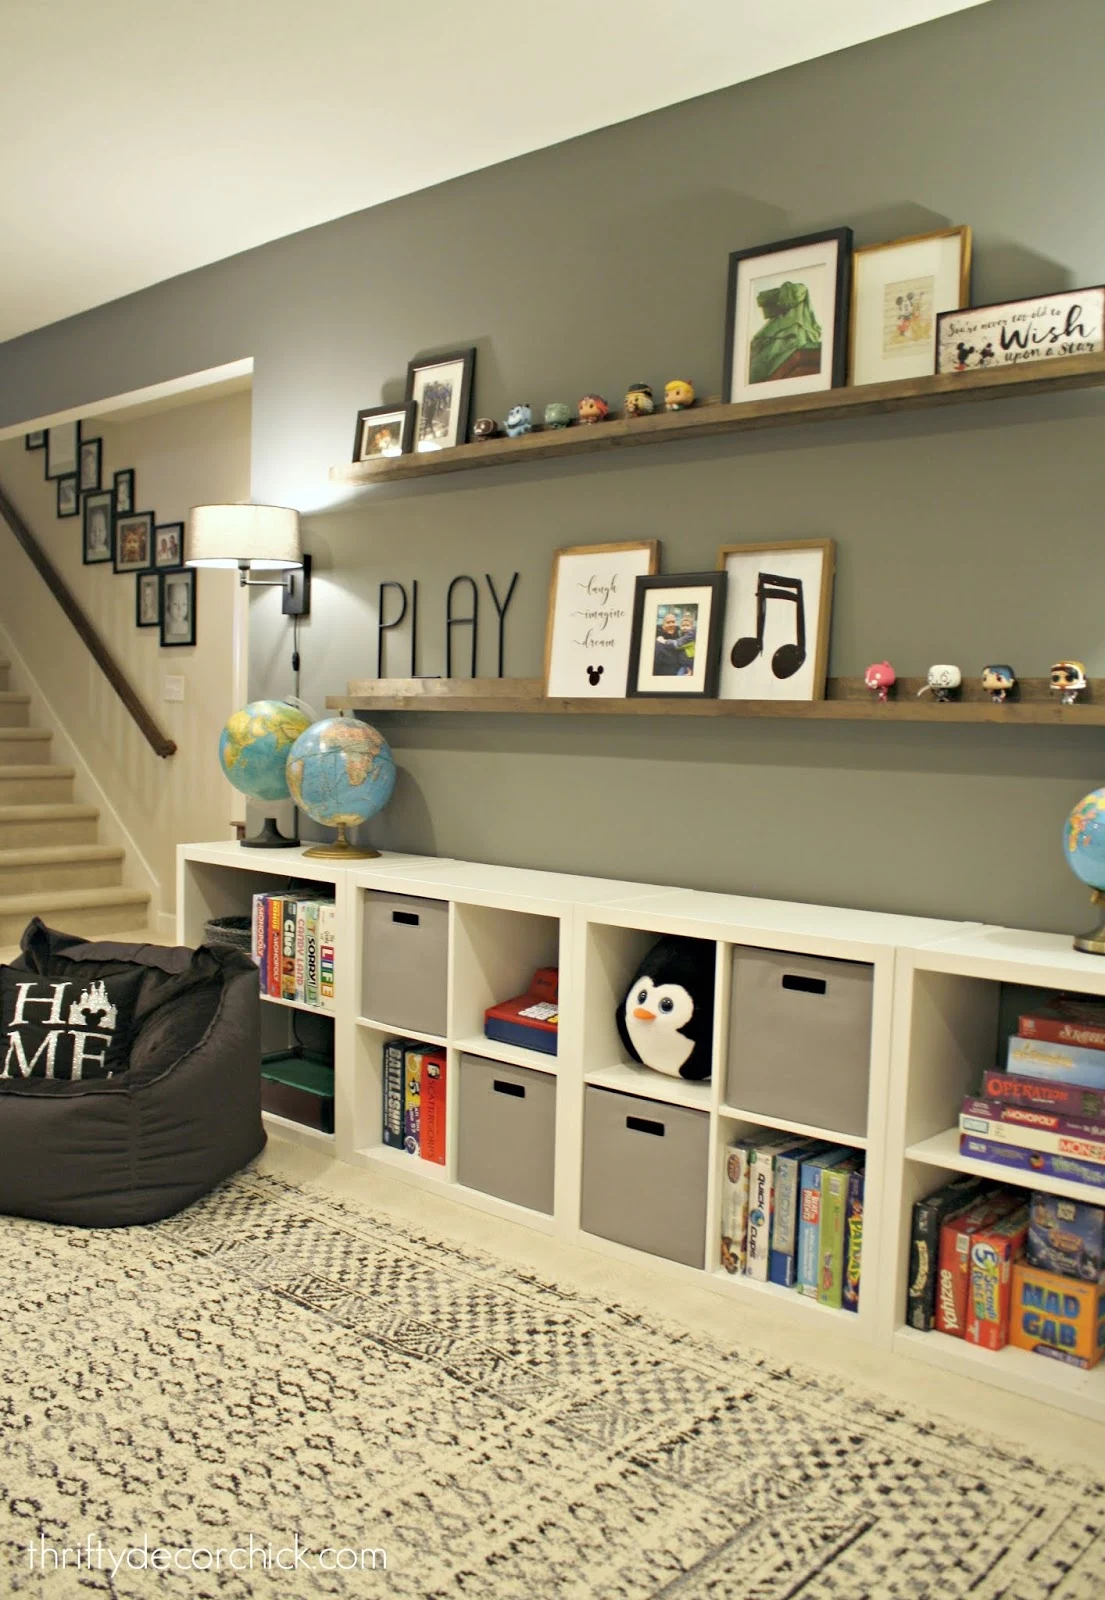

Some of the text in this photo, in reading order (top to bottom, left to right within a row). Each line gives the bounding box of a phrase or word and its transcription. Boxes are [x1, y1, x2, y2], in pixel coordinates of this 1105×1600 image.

[980, 319, 1008, 330] never
[1031, 306, 1047, 319] old
[1000, 304, 1096, 350] Wish
[1004, 346, 1040, 364] upon
[1045, 348, 1053, 356] a
[577, 573, 618, 606] laugh
[378, 571, 519, 678] PLAY
[572, 628, 615, 648] dream
[576, 609, 625, 631] imagine
[284, 919, 295, 957] Clue
[308, 938, 316, 987] SORRY!
[321, 947, 334, 997] LIFE
[388, 1047, 402, 1136] BATTLESHIP
[1006, 1108, 1057, 1127] MONOPOLY
[1022, 1282, 1080, 1319] MAD
[1022, 1311, 1077, 1349] GAB
